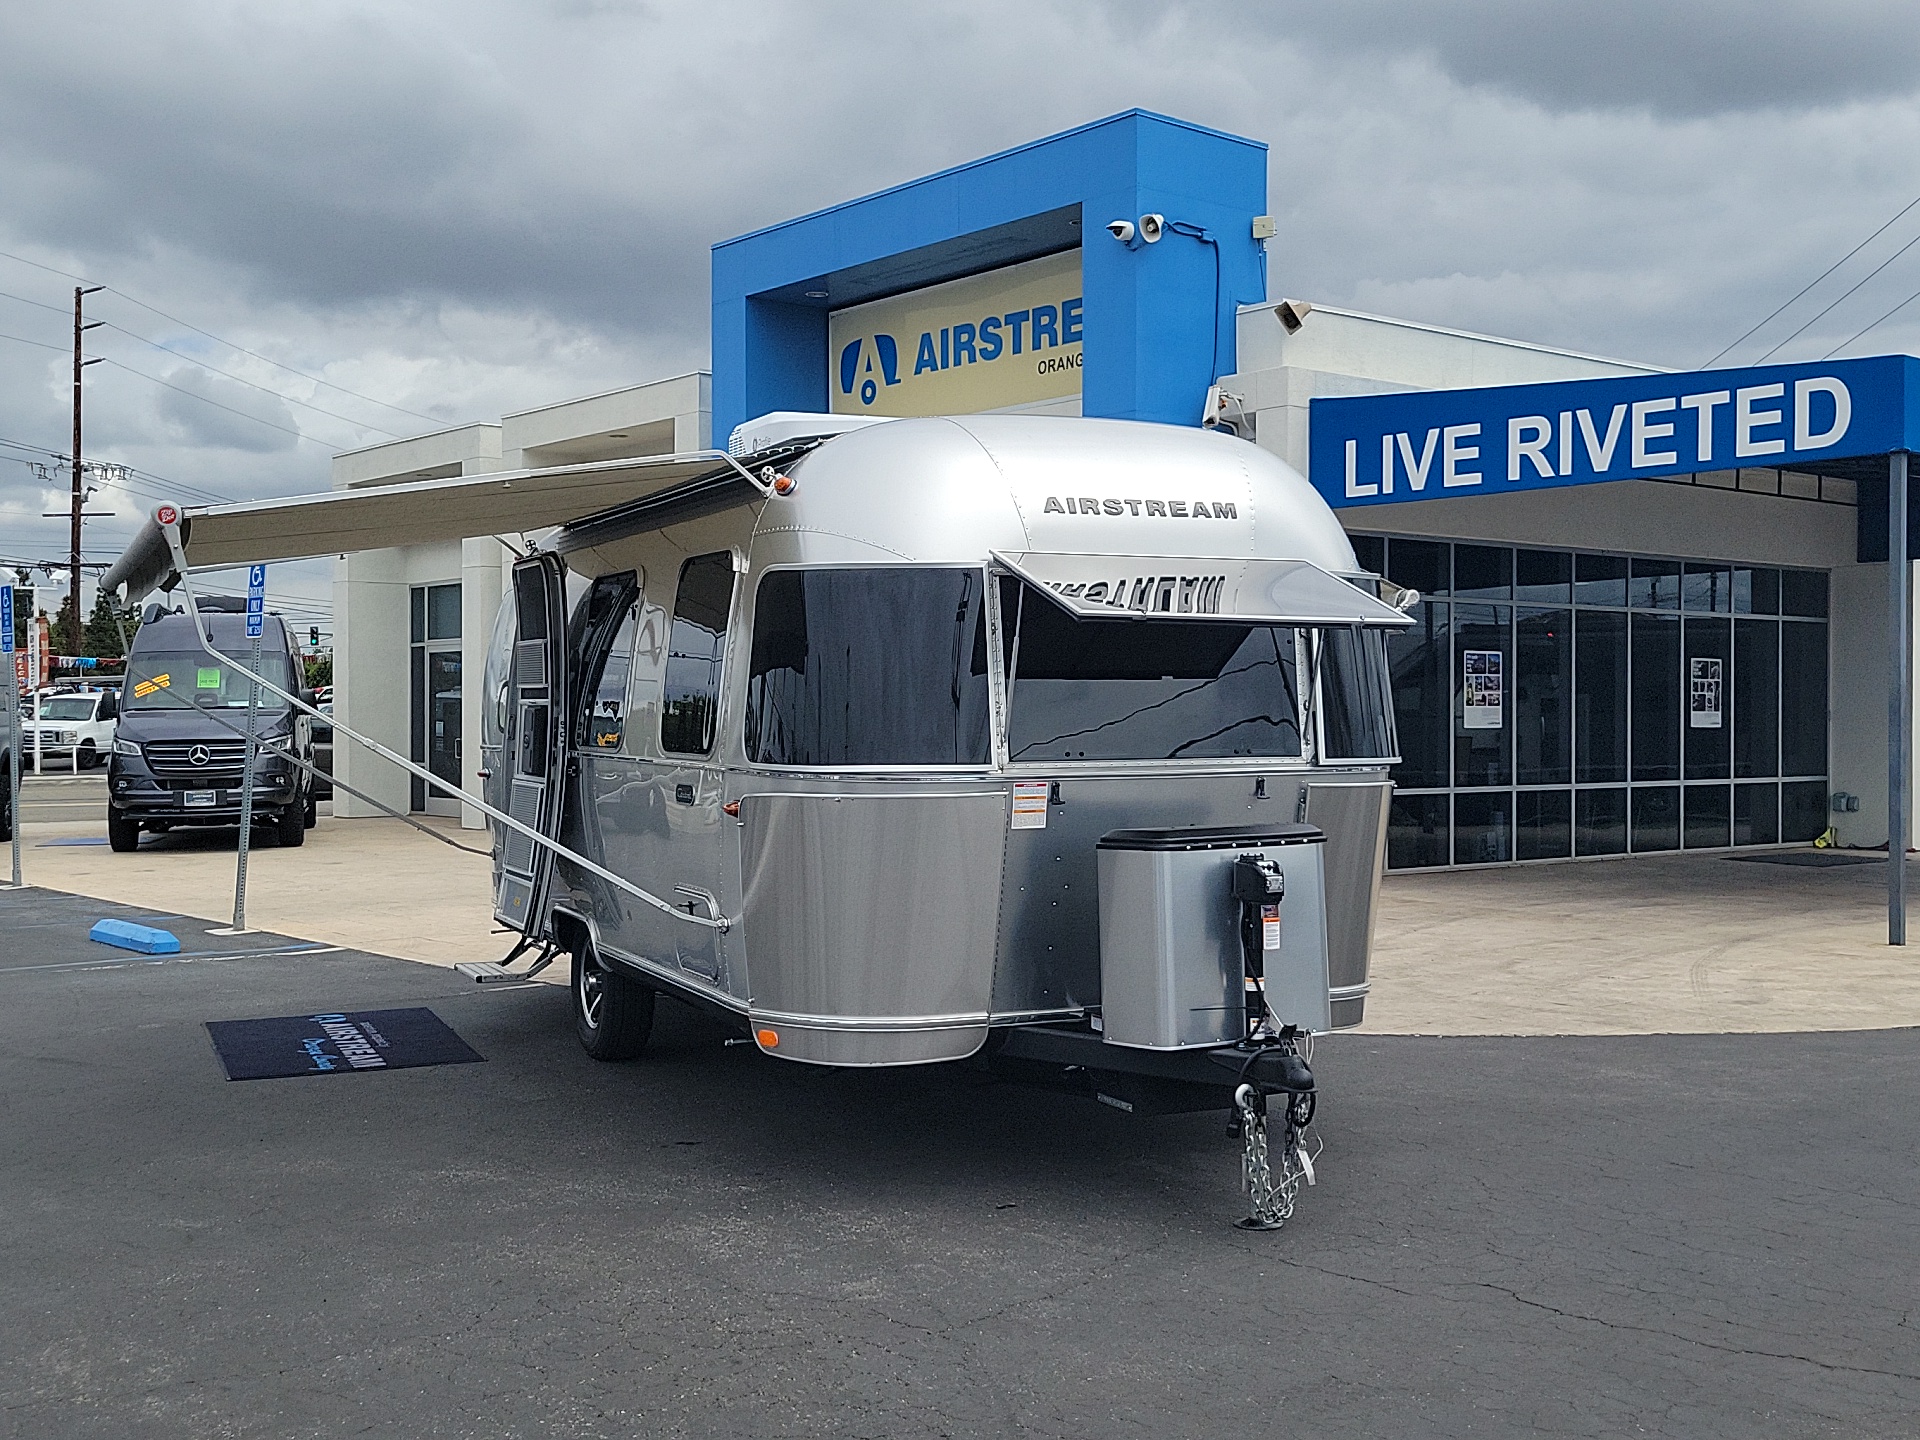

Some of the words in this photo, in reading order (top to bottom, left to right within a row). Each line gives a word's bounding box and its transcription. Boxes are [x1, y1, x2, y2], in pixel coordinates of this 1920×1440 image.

[1345, 422, 1482, 498] LIVE
[1507, 376, 1852, 481] RIVETED
[1043, 496, 1238, 519] AIRSTREAM
[321, 1023, 387, 1069] AIRSTREAM
